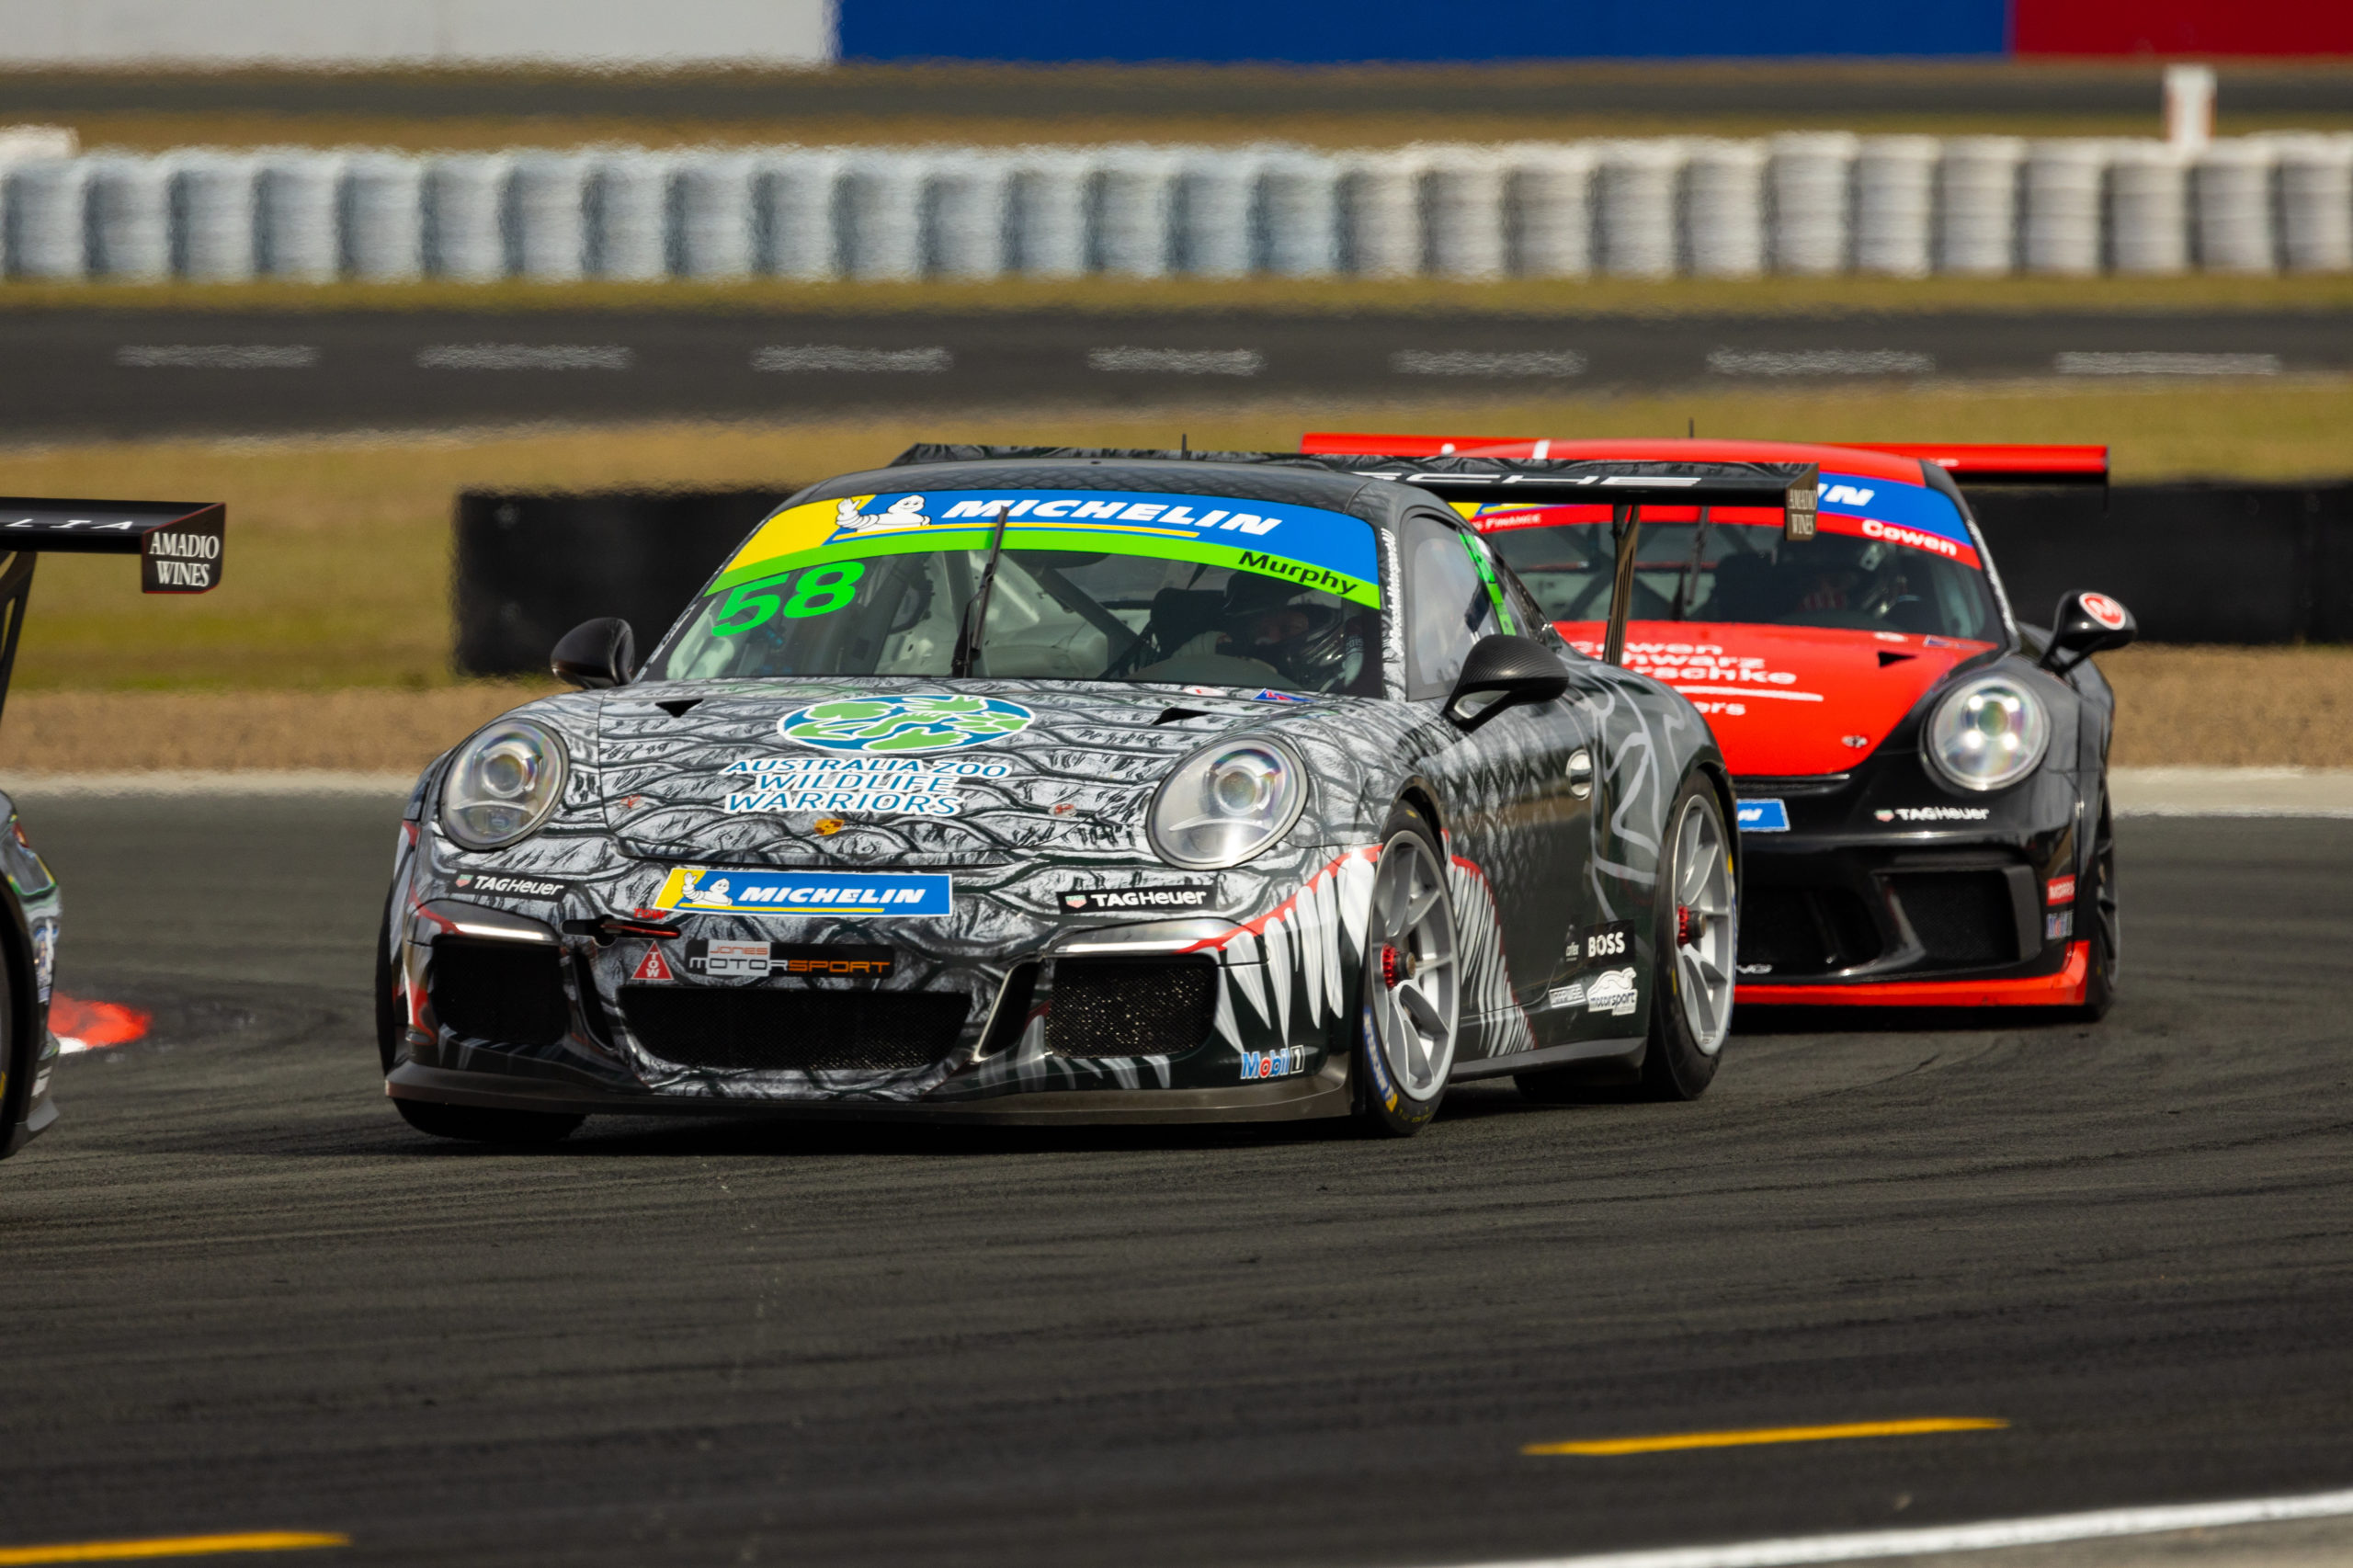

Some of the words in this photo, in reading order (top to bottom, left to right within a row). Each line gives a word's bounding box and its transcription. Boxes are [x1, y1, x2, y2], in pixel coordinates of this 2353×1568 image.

[941, 499, 1283, 536] MICHELIN
[149, 531, 220, 560] AMADIO
[1862, 519, 1958, 557] Cowen
[156, 561, 210, 587] WINES
[1238, 551, 1360, 596] Murphy
[711, 561, 866, 637] 58
[723, 758, 920, 773] AUSTRALIA
[935, 761, 1008, 778] ZOO
[759, 774, 957, 793] WILDLIFE
[728, 792, 961, 815] WARRIORS
[473, 875, 564, 896] TAGHeuer
[738, 887, 926, 903] MICHELIN
[1090, 891, 1207, 907] TAGHeuer
[633, 908, 666, 920] TOW
[709, 945, 769, 956] JONES
[1587, 931, 1626, 958] BOSS
[645, 951, 660, 978] TOW
[1240, 1047, 1290, 1080] Mobil
